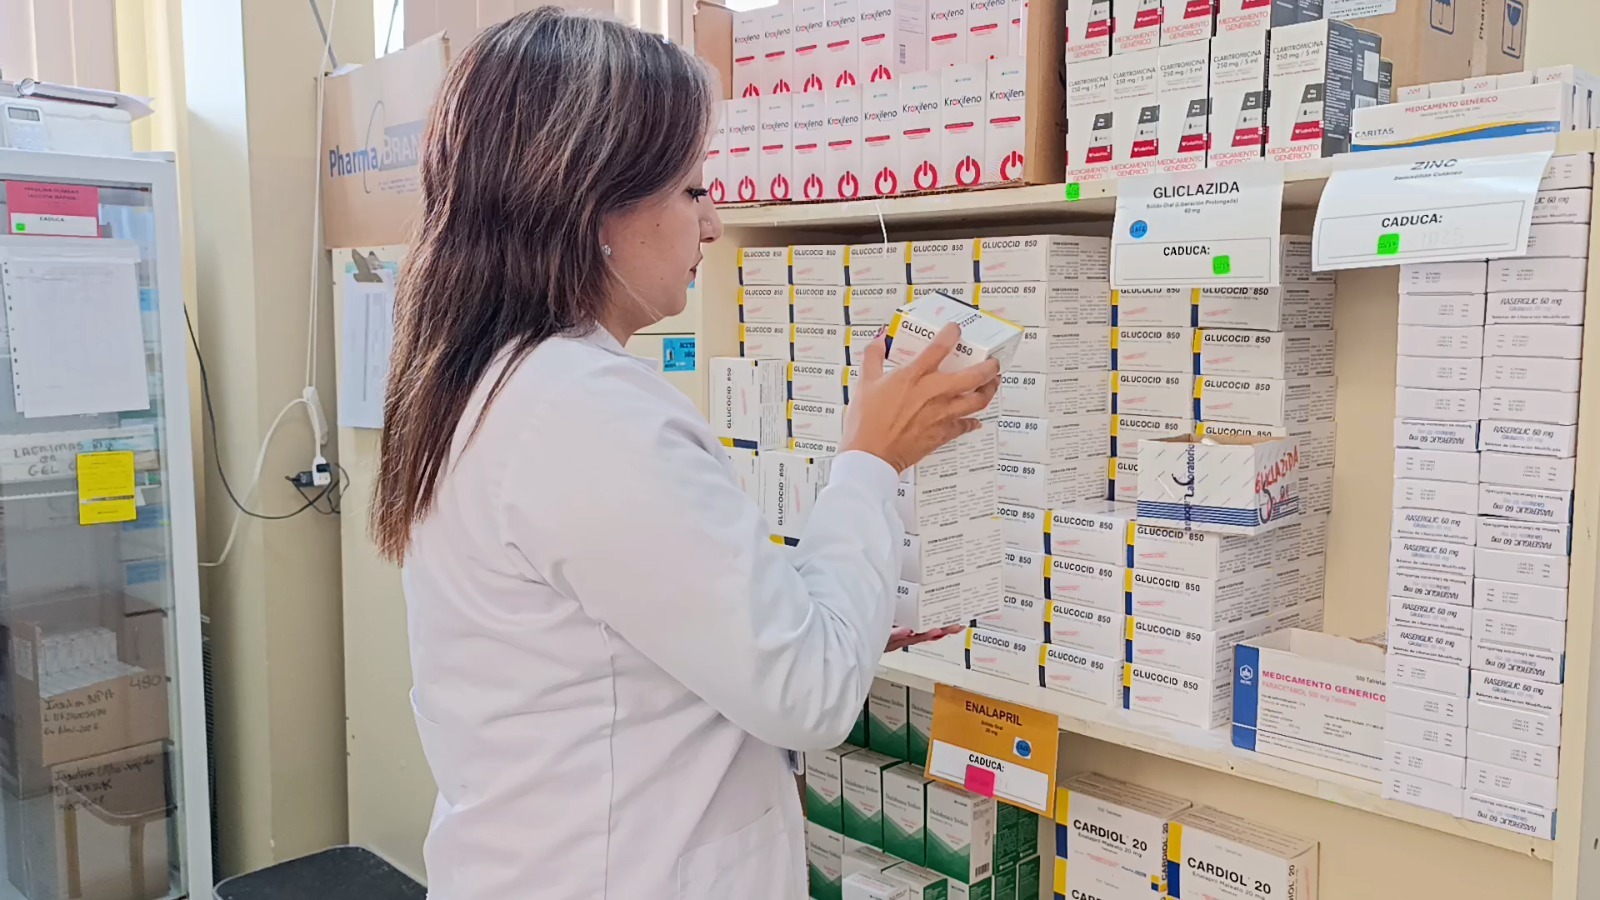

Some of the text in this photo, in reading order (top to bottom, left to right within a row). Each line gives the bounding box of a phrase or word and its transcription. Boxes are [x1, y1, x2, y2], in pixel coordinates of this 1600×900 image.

[861, 9, 891, 21] Kroxifeno
[931, 9, 964, 20] Kroxifeno
[1218, 12, 1268, 26] MEDICAMENTO
[826, 16, 855, 28] Kroxifeno
[1273, 41, 1324, 54] CLARITROMICINA
[1213, 50, 1262, 62] CLARITROMICINA
[1276, 52, 1288, 61] 250
[1289, 51, 1299, 60] mg
[1306, 49, 1310, 57] 5
[1216, 61, 1228, 69] 250
[1229, 60, 1239, 68] mg
[945, 94, 982, 107] Kroxifeno
[903, 101, 938, 113] Kroxifeno
[1405, 101, 1458, 113] MEDICAMENTO
[828, 115, 858, 127] Kroxifeno
[865, 110, 897, 121] Kroxifeno
[762, 121, 789, 131] Kroxifeno
[1354, 127, 1394, 138] CARITAS
[1268, 144, 1319, 154] MEDICAMENTO
[329, 134, 420, 177] Pharma BRAN
[1157, 155, 1203, 166] MEDICAMENTO
[1410, 158, 1457, 170] ZINC
[1153, 181, 1239, 198] GLICLAZIDA
[1382, 214, 1443, 228] CADUCA:
[851, 248, 883, 256] GLUCOCID
[913, 244, 948, 252] GLUCOCID
[1163, 246, 1210, 256] CADUCA:
[982, 286, 1019, 294] GLUCOCID
[1254, 287, 1269, 295] 850
[1120, 331, 1180, 339] GLUCOCID 850
[1204, 334, 1250, 342] GLUCOCID
[955, 343, 973, 356] 850
[794, 366, 822, 374] GLUCOCID
[1120, 375, 1179, 385] GLUCOCID 850
[1204, 380, 1270, 391] GLUCOCID 850
[1120, 419, 1160, 429] GLUCOCID
[1493, 426, 1530, 435] RASERGLIC
[1532, 427, 1541, 435] 60
[795, 441, 823, 451] GLUCOCID
[28, 465, 60, 476] GEL
[1053, 515, 1113, 530] GLUCOCID 850
[1405, 514, 1439, 525] RASERGLIC
[1137, 526, 1204, 542] GLUCOCID 850
[1053, 560, 1112, 578] GLUCOCID 850
[1135, 574, 1200, 592] GLUCOCID 850
[1053, 605, 1111, 624] GLUCOCID 850
[1135, 621, 1201, 642] GLUCOCID 850
[972, 632, 1026, 652] GLUCOCID 850
[1047, 649, 1104, 670] GLUCOCID 850
[1133, 668, 1198, 690] GLUCOCID 850
[1262, 670, 1386, 702] MEDICAMENTO GENERICO
[1262, 681, 1306, 696] PARACETAMOL
[1309, 690, 1318, 698] 500
[1320, 693, 1330, 702] mg
[1484, 677, 1544, 695] RASERGLIC 60 mg
[965, 700, 1022, 726] ENALAPRIL
[968, 754, 1005, 772] CADUCA:
[1162, 823, 1168, 834] 20
[1073, 819, 1147, 851] CARDIOL 20
[1187, 857, 1271, 894] CARDIOL 20
[1288, 865, 1295, 876] 20
